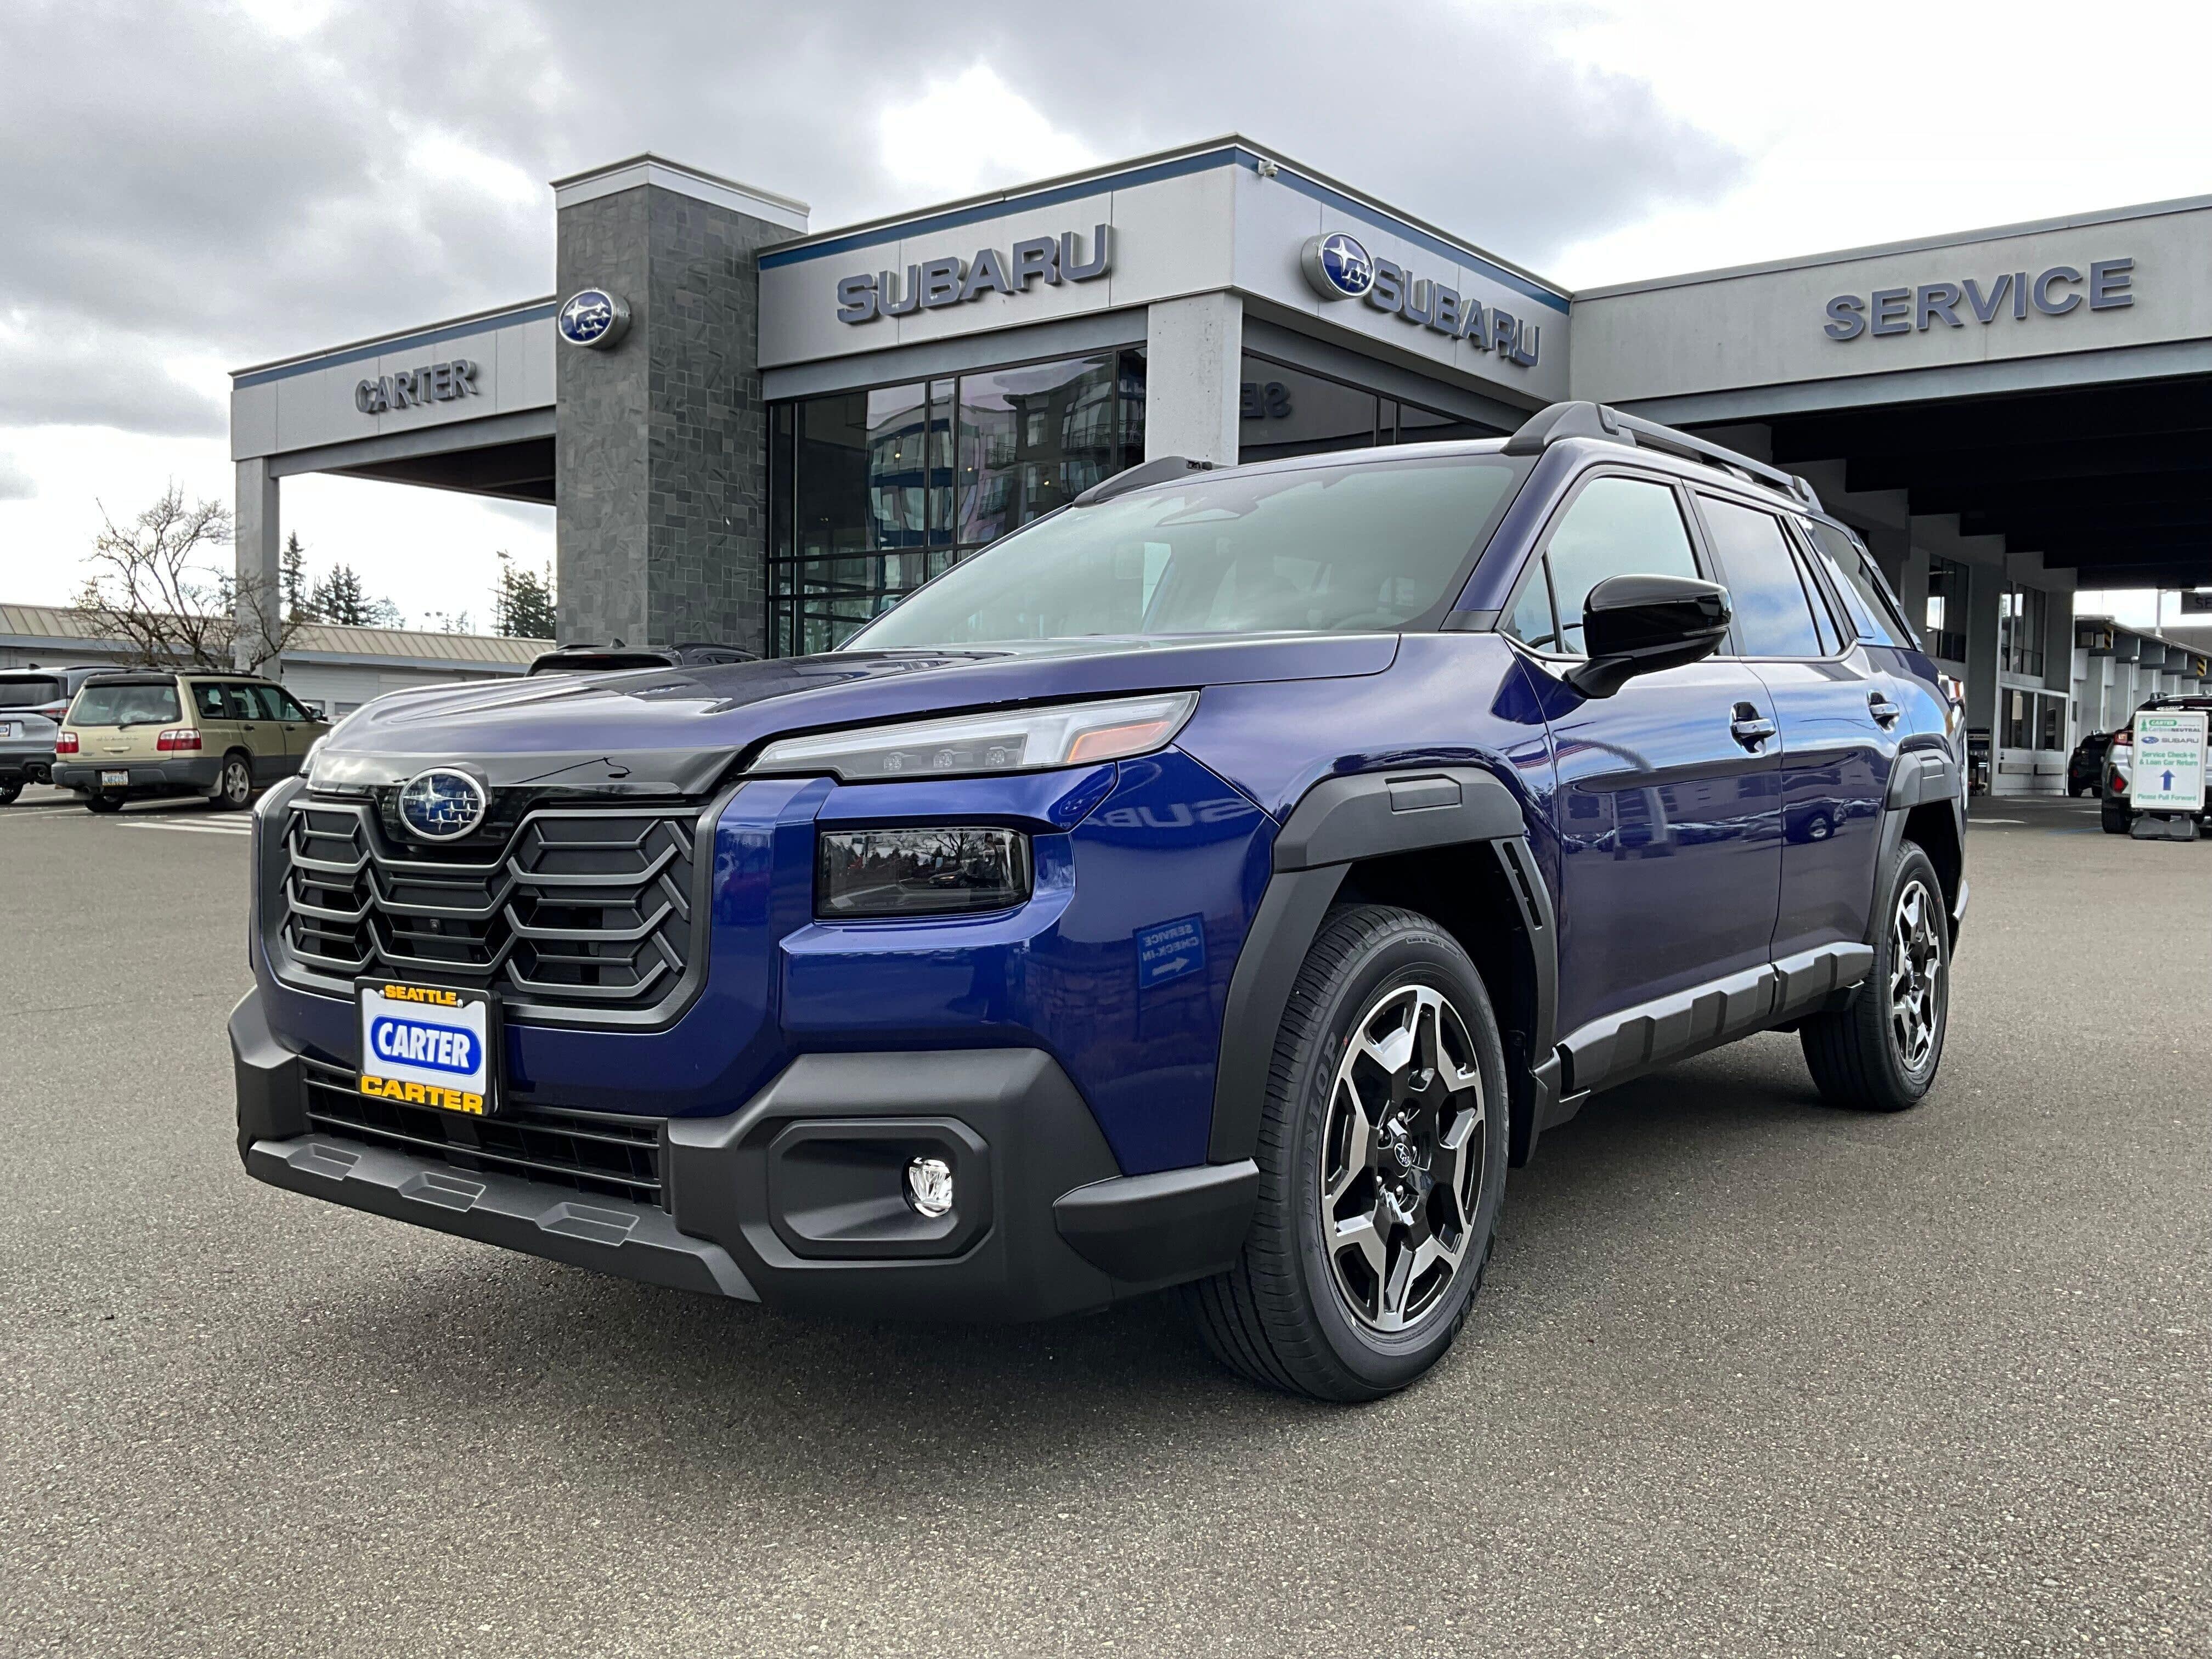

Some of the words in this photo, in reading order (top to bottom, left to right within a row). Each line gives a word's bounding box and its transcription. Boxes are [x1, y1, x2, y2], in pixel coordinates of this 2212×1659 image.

[837, 223, 1113, 325] SUBARU
[1824, 257, 2134, 341] SERVICE
[1365, 257, 1541, 366] SUBARU
[355, 359, 477, 413] CARTER
[385, 985, 458, 1006] SEATTLE
[377, 1022, 471, 1069] CARTER
[361, 1075, 483, 1115] CARTER
[1301, 1031, 1337, 1220] DUNLOP
